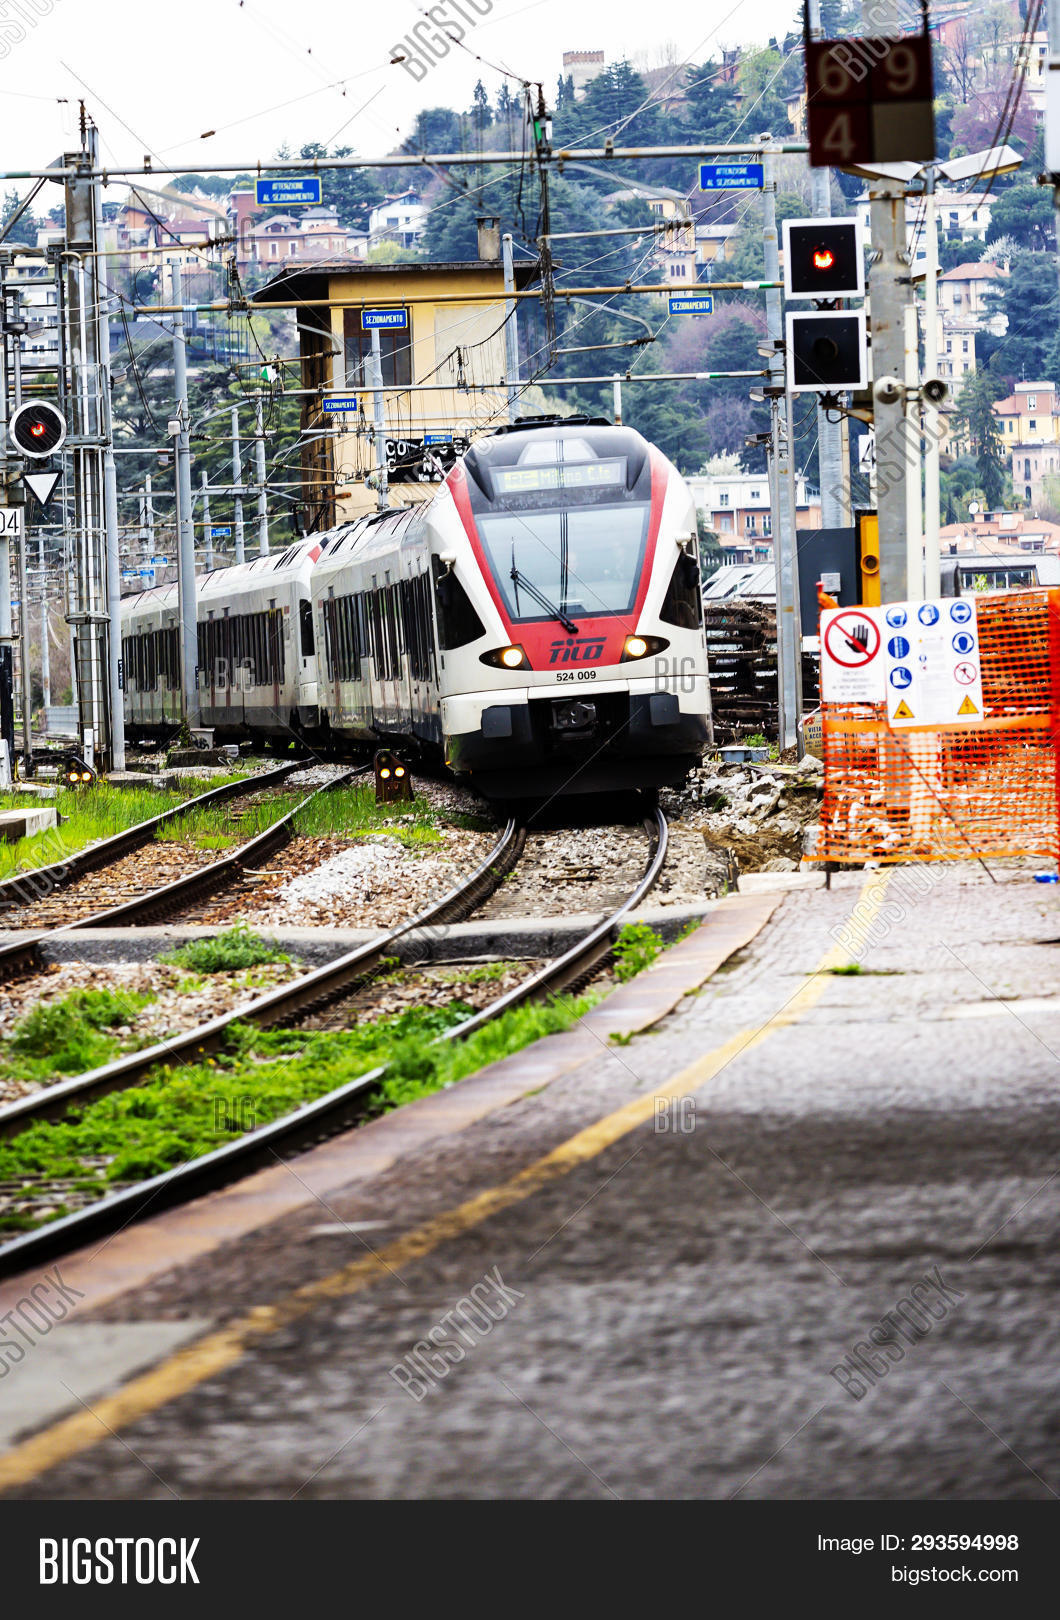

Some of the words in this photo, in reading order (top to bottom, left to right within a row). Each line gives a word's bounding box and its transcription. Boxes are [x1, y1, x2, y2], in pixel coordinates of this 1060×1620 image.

[818, 47, 850, 96] 6
[884, 45, 917, 93] 9
[822, 111, 856, 159] 4
[671, 300, 710, 310] SEZIONAMENTO
[365, 314, 404, 324] SEZIONAMENTO
[549, 636, 607, 664] TILO
[556, 672, 574, 682] 524
[577, 670, 597, 680] 009
